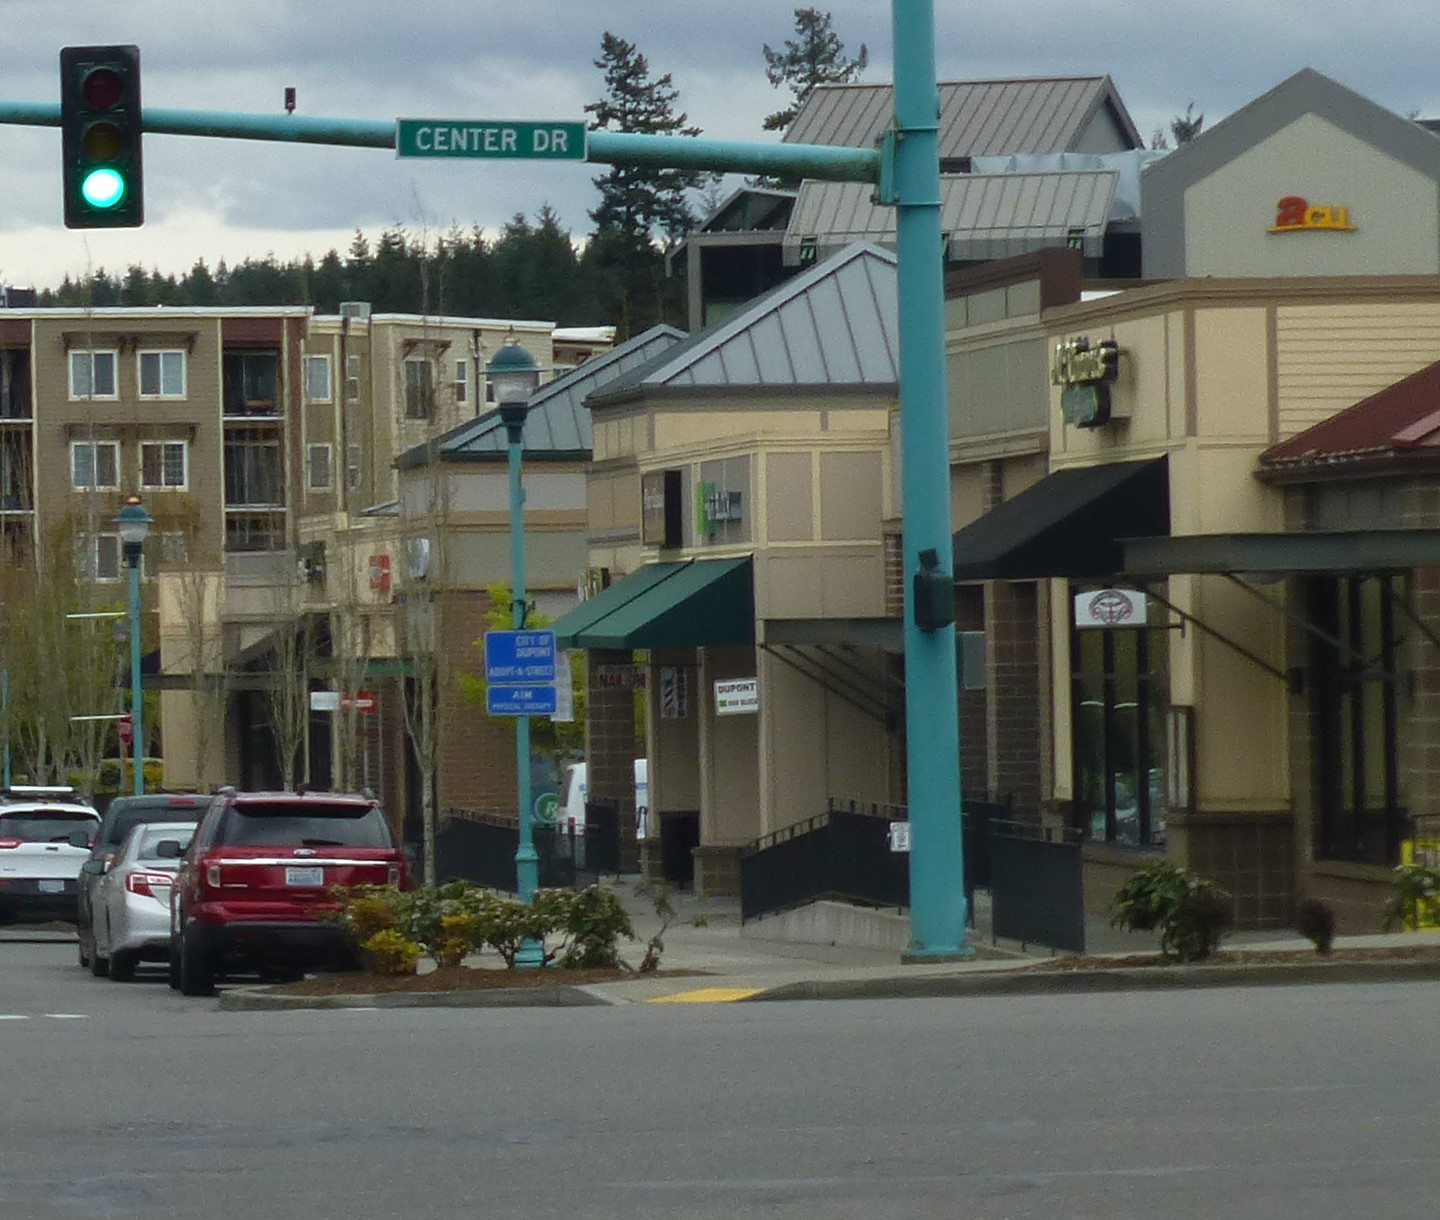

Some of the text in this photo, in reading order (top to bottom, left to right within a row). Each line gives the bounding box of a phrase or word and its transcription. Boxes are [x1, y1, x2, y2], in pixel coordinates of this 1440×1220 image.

[415, 126, 568, 152] CENTER DR
[516, 635, 551, 646] CITY OF
[516, 647, 551, 658] DUPONT
[717, 683, 755, 693] DUPONT
